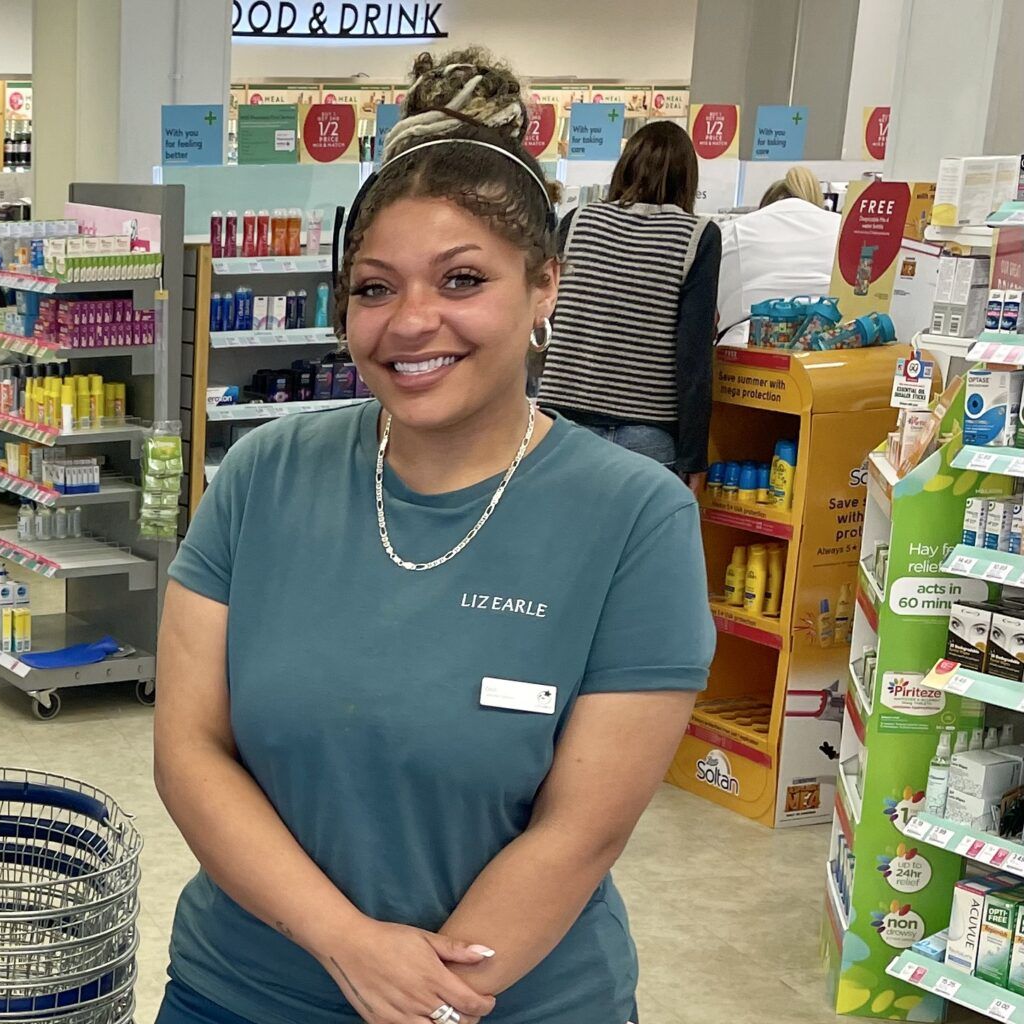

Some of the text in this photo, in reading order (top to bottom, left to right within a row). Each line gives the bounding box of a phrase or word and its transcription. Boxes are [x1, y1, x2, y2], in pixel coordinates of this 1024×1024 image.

[308, 0, 330, 33] &
[340, 2, 443, 34] DRINK
[166, 128, 199, 139] With you
[319, 122, 339, 136] 1/2
[590, 127, 602, 135] you
[706, 121, 724, 135] 1/2
[758, 128, 774, 136] With
[166, 139, 203, 150] for feeling
[572, 136, 604, 146] for taking
[767, 139, 787, 148] taking
[166, 151, 188, 159] better
[859, 199, 895, 215] FREE
[718, 372, 785, 390] Save summer with
[721, 385, 781, 402] mega protection
[829, 498, 859, 510] Save
[837, 511, 864, 524] with
[817, 545, 843, 555] Always
[909, 543, 939, 557] Hay
[917, 583, 961, 594] acts in
[461, 593, 547, 617] LIZ EARLE
[899, 597, 918, 608] 60
[894, 686, 942, 698] Piriteze
[697, 761, 738, 795] Soltan
[898, 861, 922, 871] up to
[896, 869, 922, 878] 24hr
[897, 878, 920, 887] relief
[988, 908, 1008, 916] OPTI-
[887, 918, 918, 930] non
[966, 899, 980, 950] ACUVUE
[988, 916, 1007, 924] FREE
[886, 928, 918, 938] drowsy
